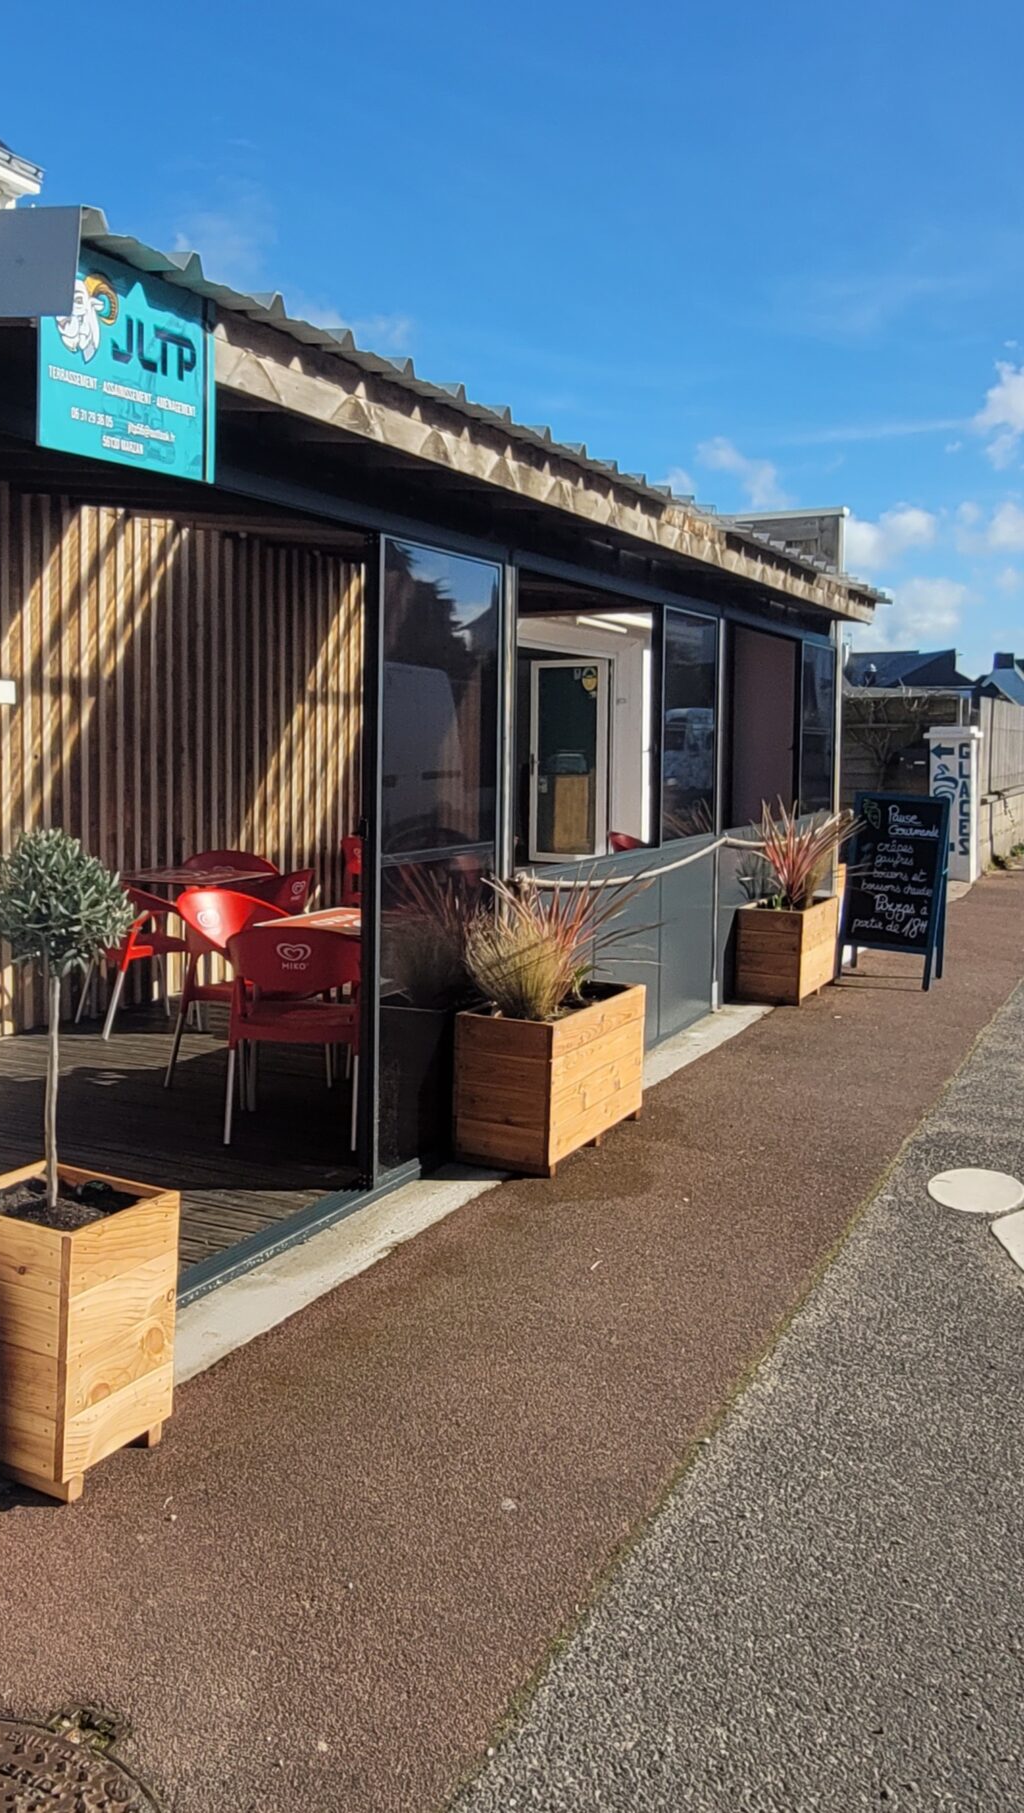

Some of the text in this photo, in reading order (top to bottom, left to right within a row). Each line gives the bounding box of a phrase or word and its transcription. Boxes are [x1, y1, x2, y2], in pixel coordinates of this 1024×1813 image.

[110, 314, 197, 382] JLTP
[958, 742, 971, 856] GLACES
[888, 804, 921, 824] Pause
[874, 852, 914, 867] gaufres
[873, 893, 929, 921] Pizzas à
[885, 921, 901, 934] de
[281, 961, 307, 970] MIKO
